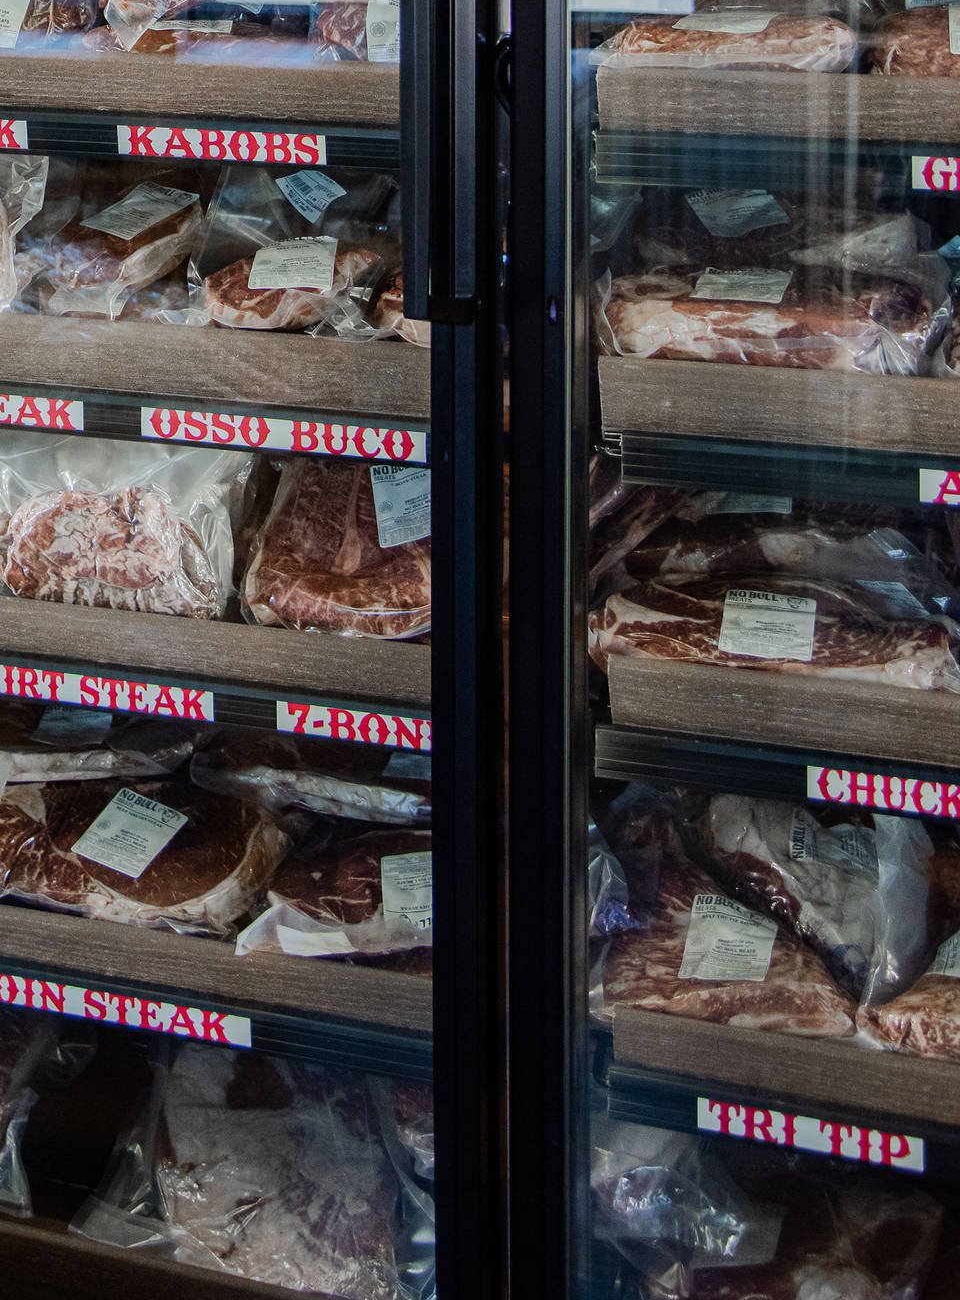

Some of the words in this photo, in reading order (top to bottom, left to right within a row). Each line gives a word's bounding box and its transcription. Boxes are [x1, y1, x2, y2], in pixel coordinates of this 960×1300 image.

[128, 125, 321, 165] KABOBS
[921, 156, 960, 191] G
[150, 408, 271, 447] OSSO
[291, 420, 415, 461] BUCO
[373, 466, 389, 476] NO
[728, 590, 746, 598] NO
[748, 592, 779, 602] BULL
[79, 675, 207, 722] STEAK
[287, 701, 432, 751] 7-BON
[120, 788, 136, 801] NO
[135, 796, 159, 812] BULL
[696, 895, 713, 906] NO
[84, 989, 231, 1044] STEAK
[708, 1099, 797, 1147] TRI
[819, 1120, 912, 1166] TIP
